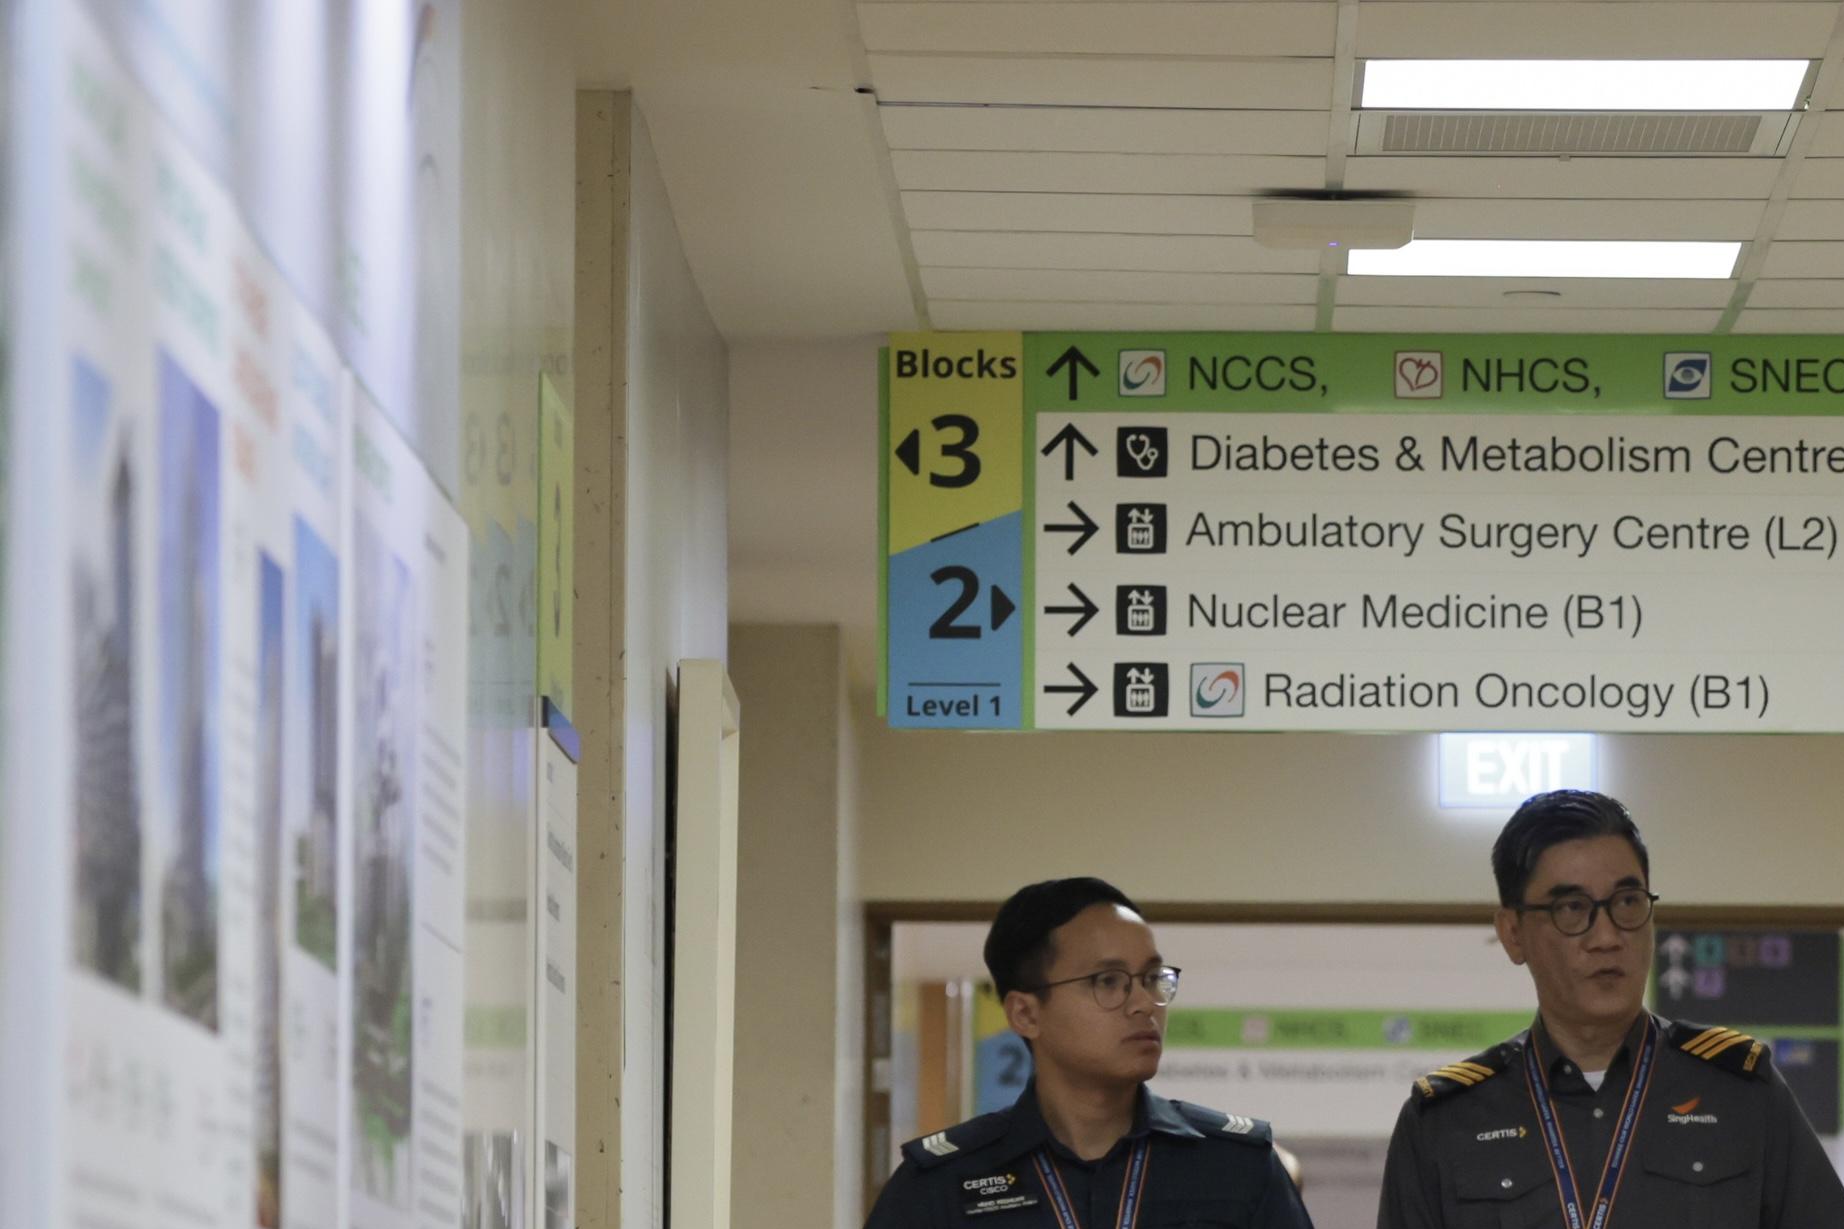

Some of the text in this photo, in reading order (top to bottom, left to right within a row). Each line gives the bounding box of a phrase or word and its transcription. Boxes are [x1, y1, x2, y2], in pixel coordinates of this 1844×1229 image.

[896, 348, 1017, 379] Blocks
[1188, 355, 1329, 397] NCCS,
[1461, 356, 1602, 398] NHCS,
[929, 413, 983, 489] 3
[1191, 434, 1380, 472] Diabetes
[1395, 435, 1425, 472] &
[1440, 434, 1692, 473] Metabolism
[1185, 511, 1839, 561] Ambulatory Surgery Centre (L2)
[928, 564, 983, 640] 2
[1188, 593, 1642, 640] Nuclear Medicine (B1)
[906, 693, 1000, 717] Level 1
[1265, 672, 1770, 719] Radiation Oncology (B1)
[1466, 740, 1570, 795] EXIT
[998, 1043, 1026, 1088] 2
[1476, 1128, 1518, 1142] CERTIS
[1667, 1113, 1718, 1125] SingHealth
[963, 1176, 1006, 1190] CERTIS
[980, 1185, 1008, 1195] CISCO
